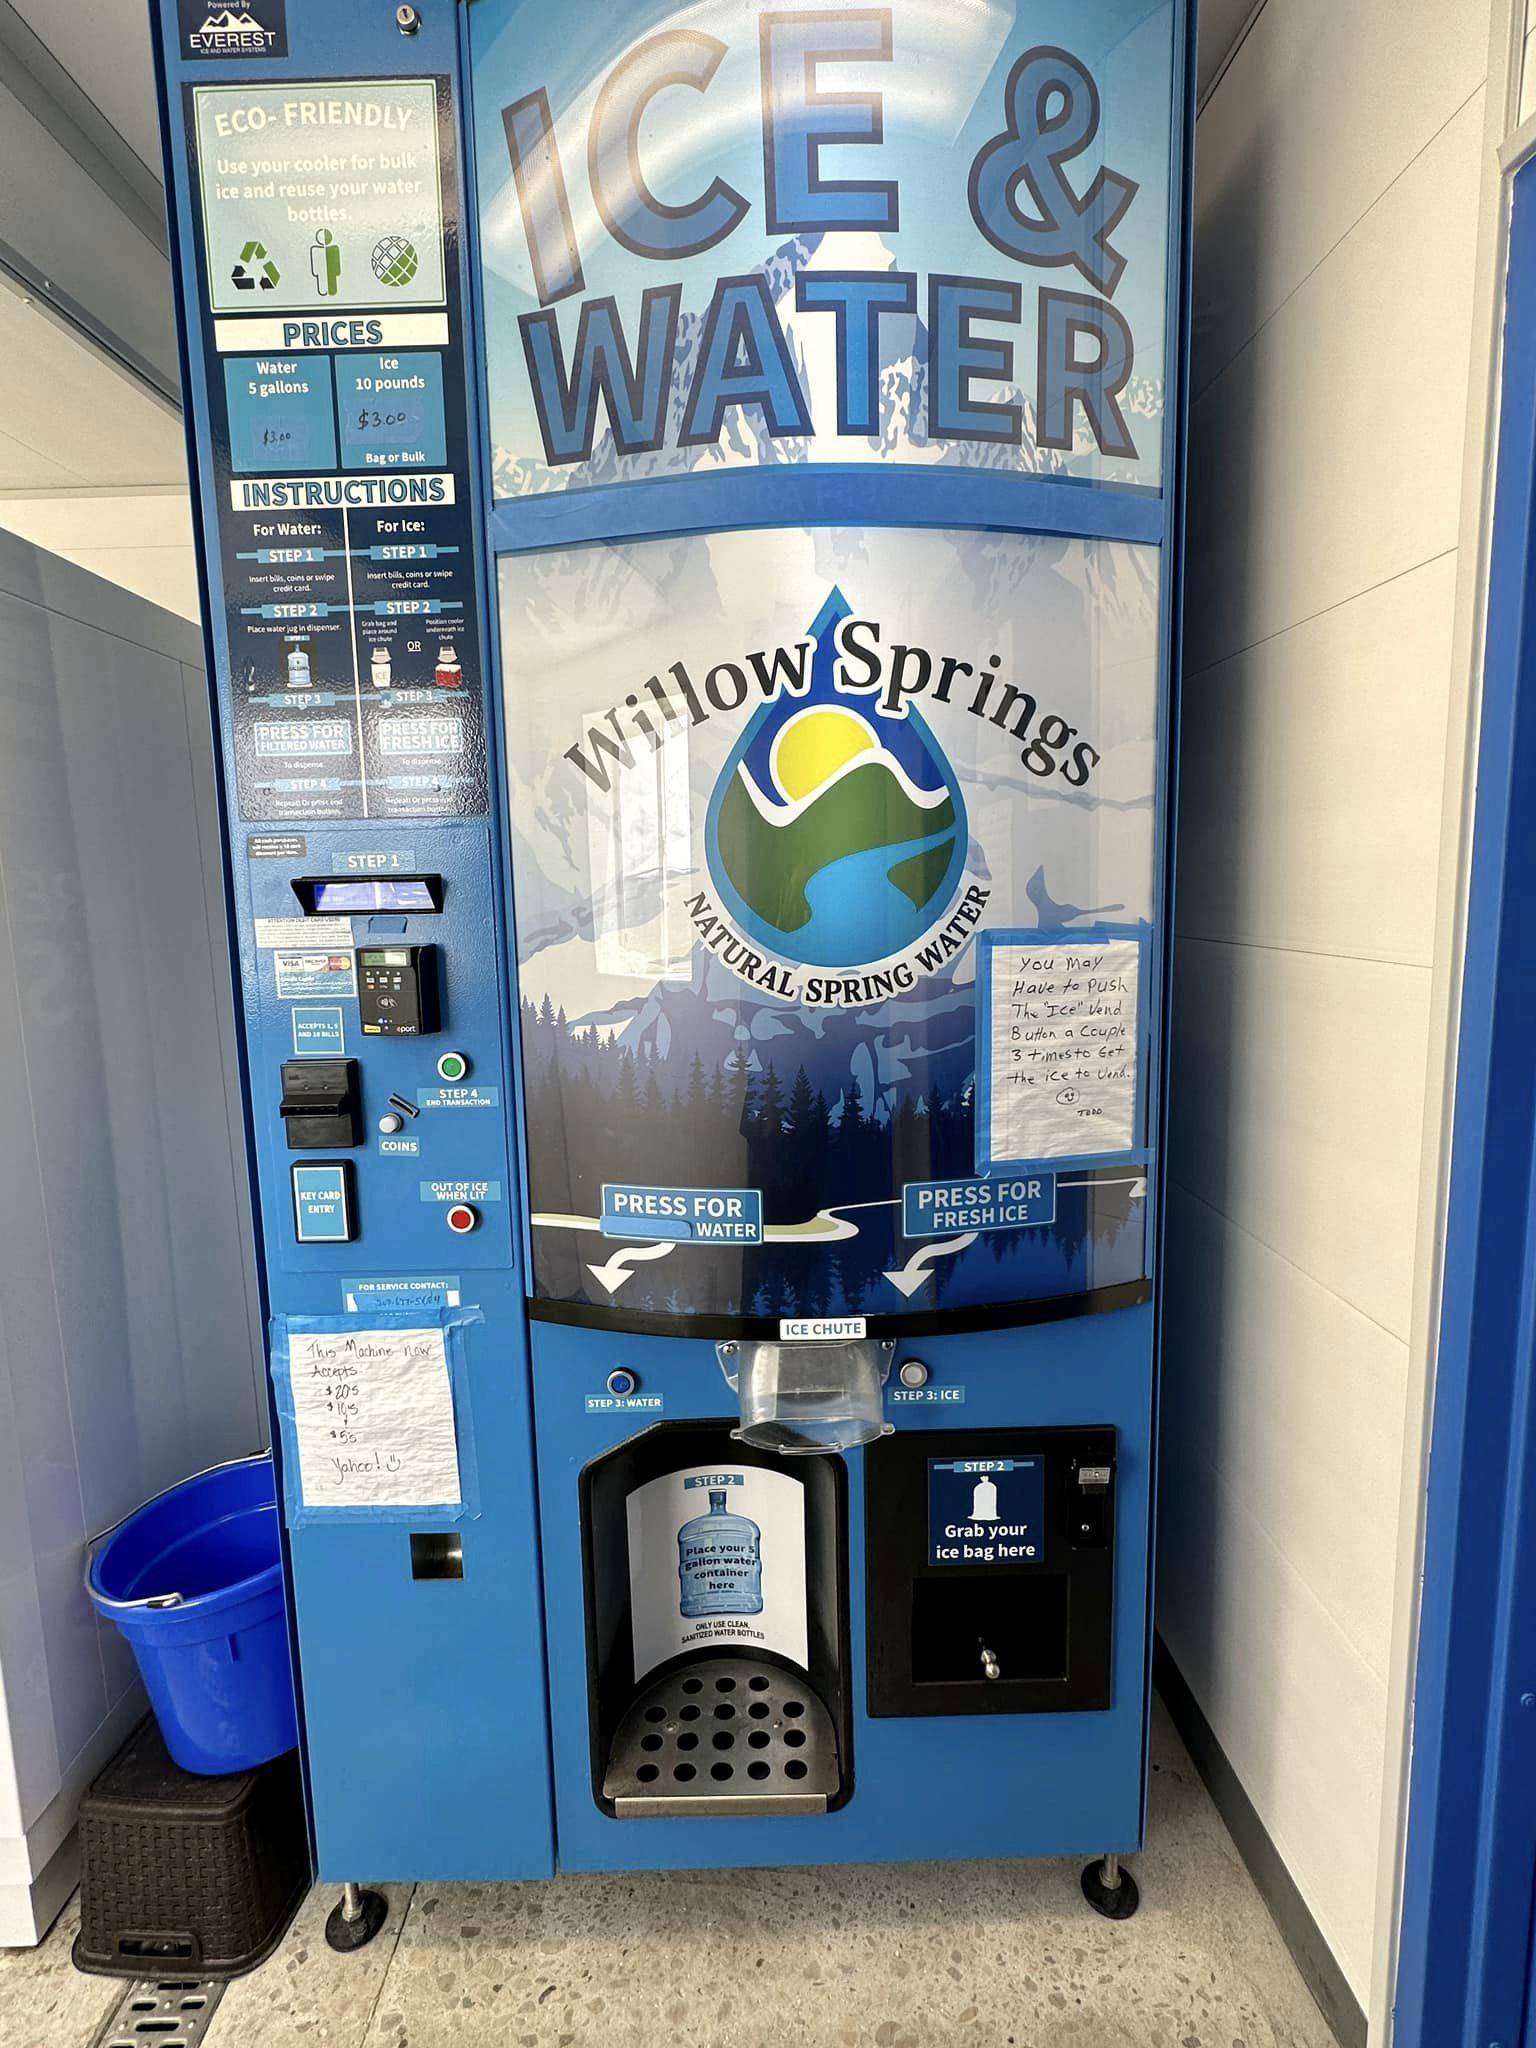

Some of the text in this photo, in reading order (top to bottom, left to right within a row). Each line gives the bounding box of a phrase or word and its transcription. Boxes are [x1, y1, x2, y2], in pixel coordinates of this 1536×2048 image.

[190, 32, 276, 48] EVEREST
[214, 101, 413, 138] ECO- FRIENDLY
[217, 152, 417, 176] Use your cooler for bulk
[500, 8, 1140, 308] ICE &
[216, 179, 422, 199] ice and reuse your water
[288, 205, 352, 222] bottles.
[282, 320, 384, 346] PRICES
[256, 362, 298, 375] Water
[379, 357, 399, 370] Ice
[516, 270, 1140, 466] WATER
[248, 380, 309, 397] 5 gallons
[355, 376, 425, 392] 10 pounds
[358, 409, 406, 430] $3.00
[366, 452, 425, 465] Bag or Bulk
[242, 478, 446, 507] INSTRUCTIONS
[253, 524, 322, 536] For Water:
[376, 520, 424, 532] For Ice:
[270, 550, 314, 562] STEP 1
[382, 546, 427, 558] STEP 1
[406, 570, 424, 578] coins
[434, 570, 453, 578] swipe
[273, 605, 318, 617] STEP 2
[386, 602, 430, 614] STEP 2
[407, 641, 421, 652] OR
[284, 694, 320, 704] STEP 3
[396, 692, 432, 701] STEP 3
[562, 621, 1100, 794] Willow Springs
[260, 725, 344, 740] PRESS FOR
[383, 722, 458, 736] PRESS FOR
[261, 740, 346, 751] FILTERED WATER
[384, 735, 458, 750] FRESH ICE
[348, 855, 400, 868] STEP 1
[683, 884, 991, 1004] NATURAL SPRING WATER
[1012, 979, 1080, 996] Have to
[1012, 1002, 1084, 1018] The "Ice"
[1012, 1025, 1126, 1042] Button a Couple
[1012, 1050, 1022, 1062] 3
[1028, 1049, 1072, 1062] times
[1074, 1048, 1090, 1059] to
[1006, 1068, 1090, 1084] the ice to
[440, 1089, 478, 1098] STEP 4
[382, 1142, 417, 1152] COINS
[432, 1182, 488, 1192] OUT OF ICE
[301, 1192, 340, 1200] KEY CARD
[436, 1192, 485, 1200] WHEN LIT
[918, 1180, 1042, 1209] PRESS FOR
[308, 1205, 335, 1214] ENTRY
[614, 1193, 742, 1218] PRESS FOR
[932, 1205, 1030, 1229] FRESH ICE
[696, 1220, 757, 1239] WATER
[410, 1282, 448, 1290] CONTACT:
[786, 1321, 862, 1337] ICE CHUTE
[307, 1339, 394, 1358] This Machine
[893, 1390, 960, 1402] STEP 3: ICE
[587, 1398, 662, 1410] STEP 3: WATER
[332, 1452, 380, 1485] Yahoo!
[964, 1461, 1004, 1472] STEP 2
[695, 1476, 735, 1487] STEP 2
[945, 1524, 1028, 1540] Grab your
[686, 1544, 755, 1556] Place your 5
[936, 1544, 1036, 1560] ice bag here
[684, 1557, 757, 1572] gallon water
[694, 1568, 750, 1580] container
[709, 1581, 735, 1590] here
[696, 1622, 712, 1632] ONLY
[728, 1620, 750, 1630] CLEAN,
[682, 1631, 713, 1644] SANITIZED
[737, 1630, 764, 1640] BOTTLES
